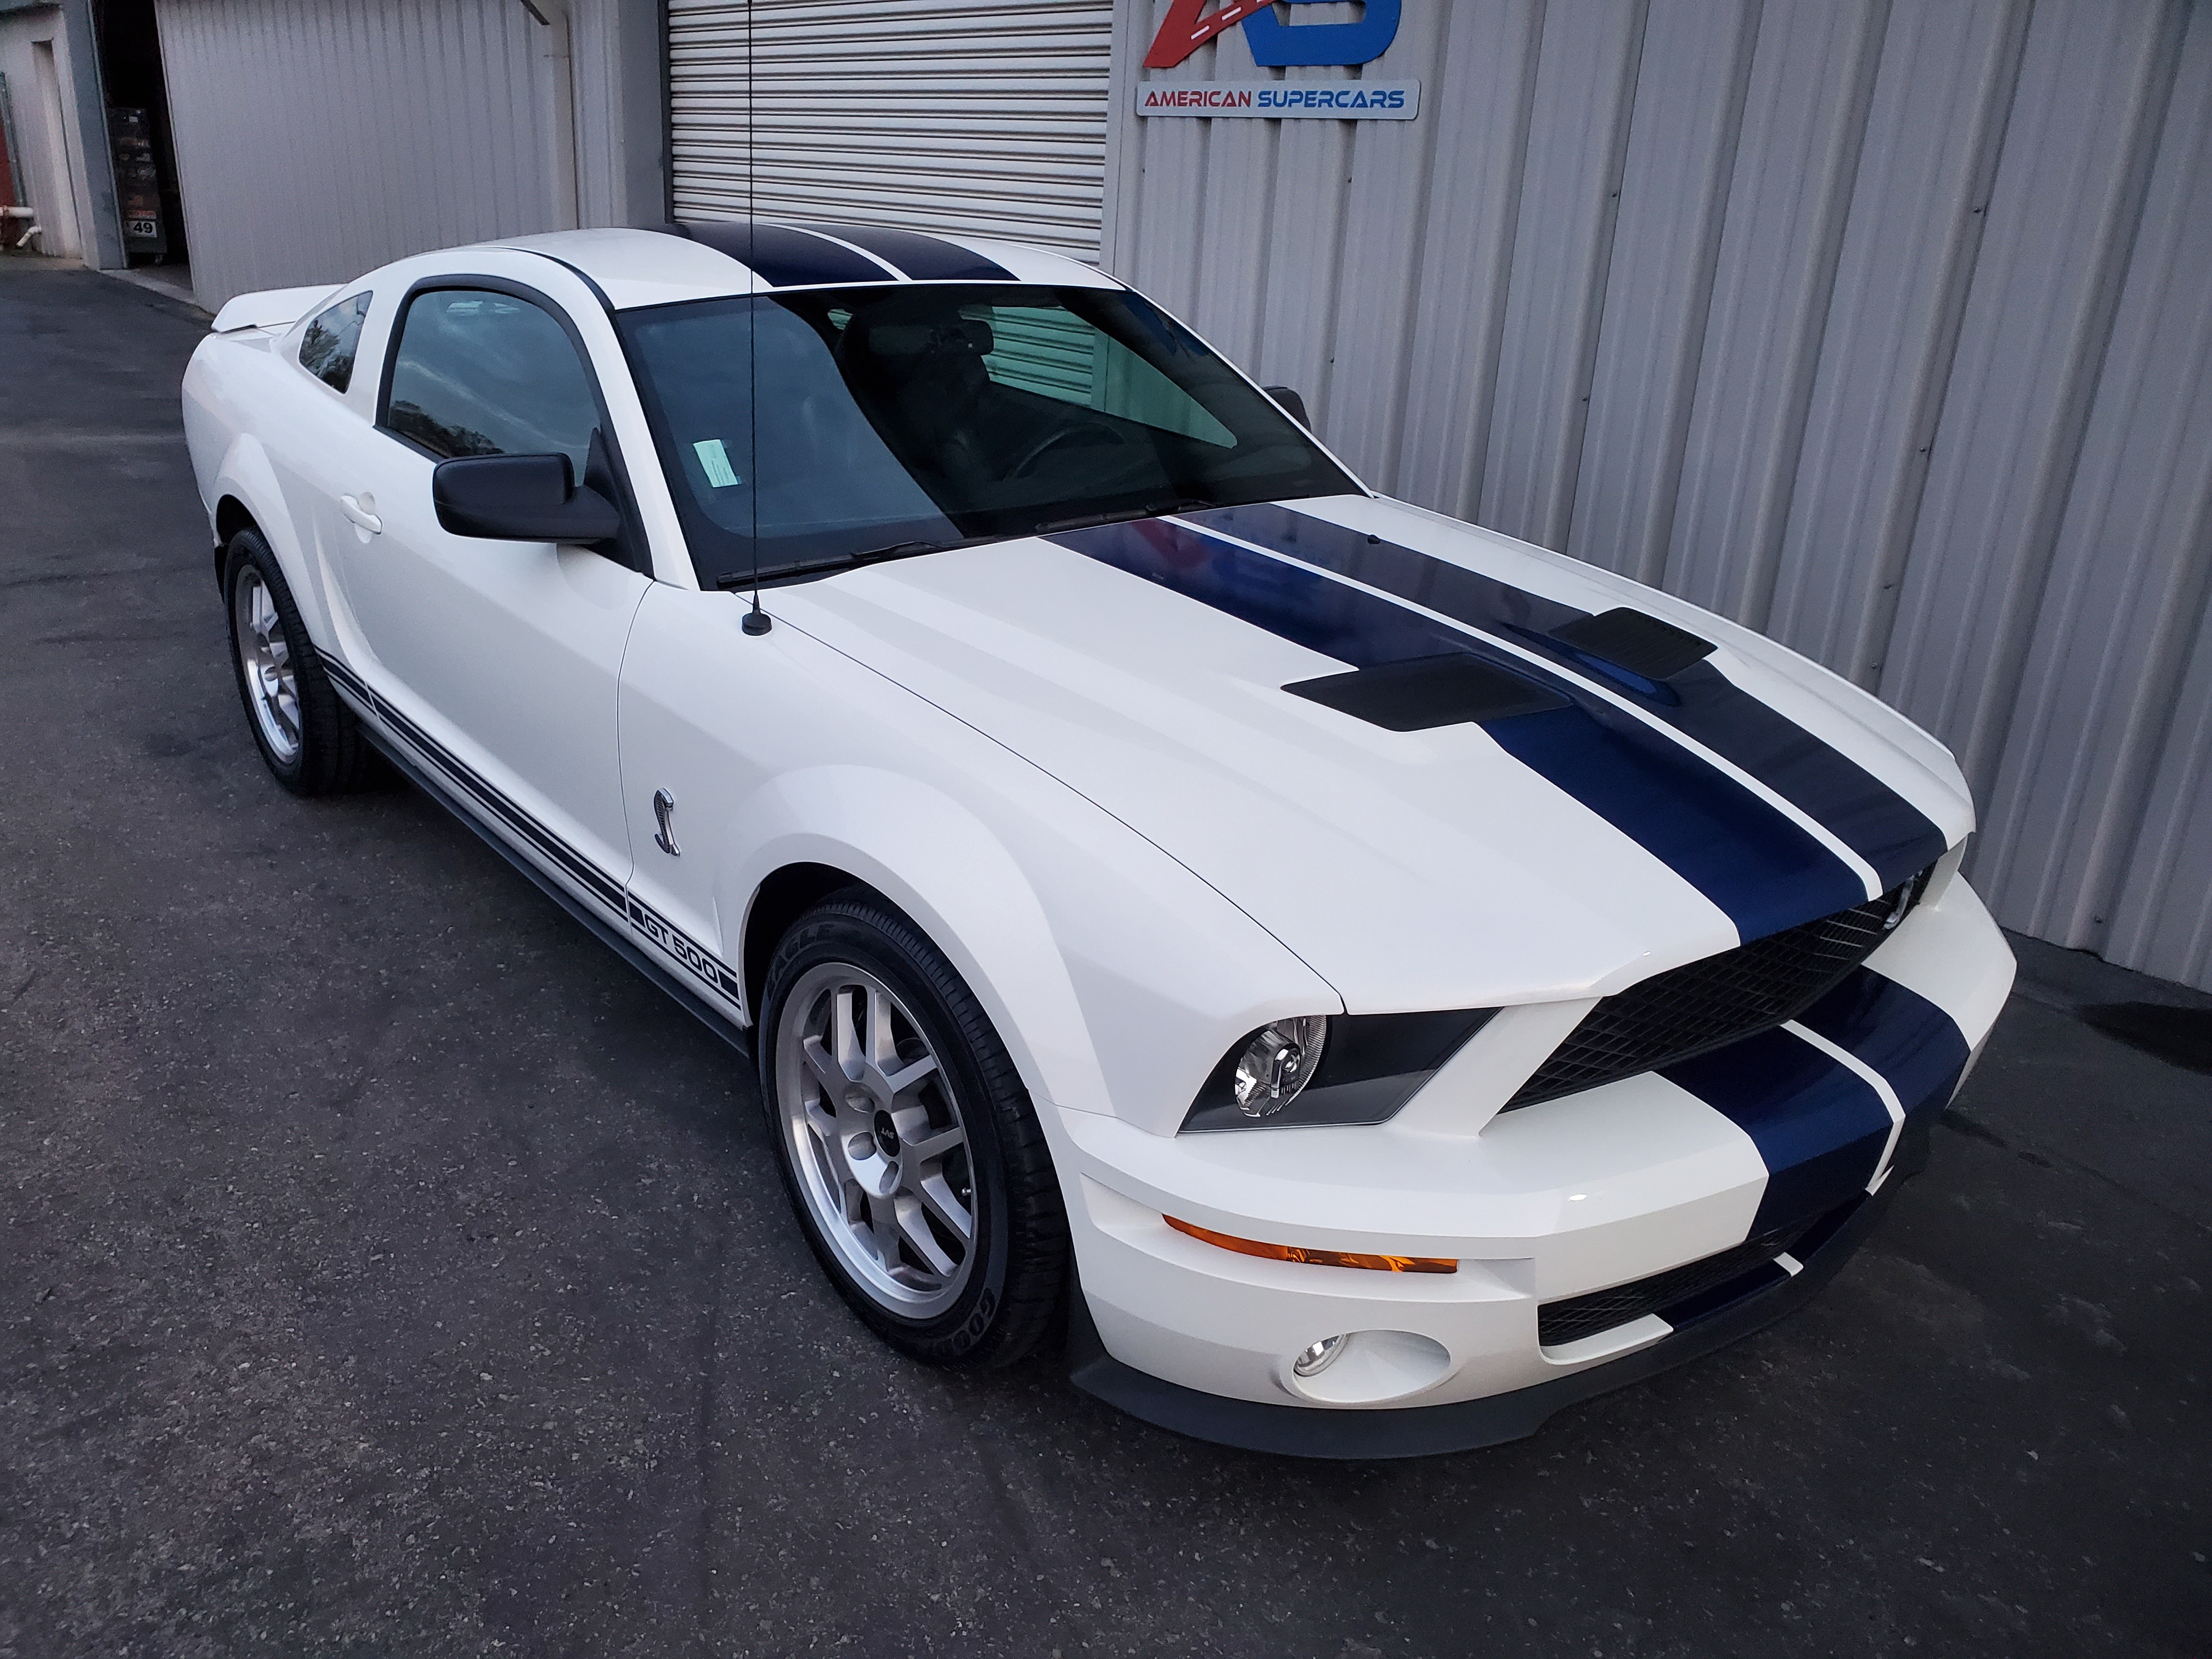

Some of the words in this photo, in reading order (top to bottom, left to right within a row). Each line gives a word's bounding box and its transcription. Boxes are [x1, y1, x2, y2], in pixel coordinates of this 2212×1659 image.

[1144, 90, 1252, 107] AMERICAN
[1257, 90, 1405, 109] SUPERCARS
[133, 222, 153, 234] 49
[645, 913, 669, 945] GT
[672, 934, 719, 984] 500
[881, 1127, 895, 1139] SVT
